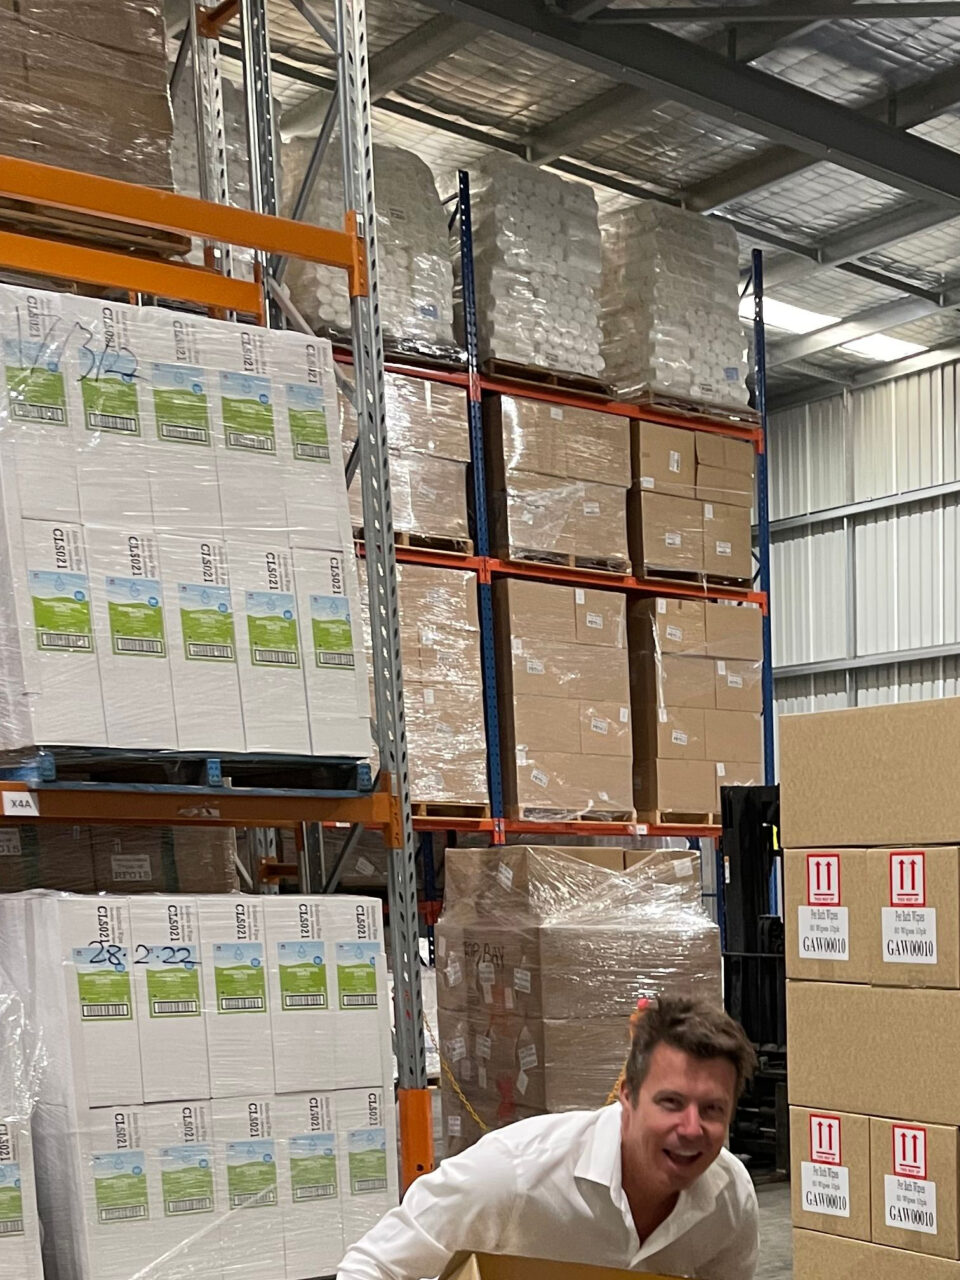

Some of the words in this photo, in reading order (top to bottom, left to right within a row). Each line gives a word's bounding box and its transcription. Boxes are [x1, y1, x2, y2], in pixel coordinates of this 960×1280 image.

[241, 332, 254, 372] CLS021
[53, 528, 68, 569] CLS021
[129, 536, 143, 576] CLS021
[201, 544, 214, 582] CLS021
[266, 552, 279, 591] CLS021
[330, 558, 342, 595] CLS021
[11, 799, 32, 809] X4A
[98, 906, 110, 943] CLS021
[168, 905, 181, 941] CLS021
[236, 904, 248, 940] CLS021
[299, 904, 310, 939] CLS021
[356, 905, 367, 939] CLS021
[818, 909, 826, 920] Bath
[827, 909, 839, 922] Wipes
[903, 911, 911, 922] Bath
[912, 911, 925, 924] Wipes
[803, 936, 846, 954] GAW00010
[887, 939, 934, 957] GAW00010
[183, 1107, 195, 1143] CLS021
[249, 1102, 260, 1138] CLS021
[310, 1097, 321, 1131] CLS021
[368, 1093, 378, 1126] CLS021
[115, 1113, 128, 1149] CLS021
[806, 1190, 847, 1210] GAW00010
[904, 1180, 912, 1192] Bath
[913, 1181, 925, 1195] Wipes
[890, 1205, 934, 1227] GAW00010
